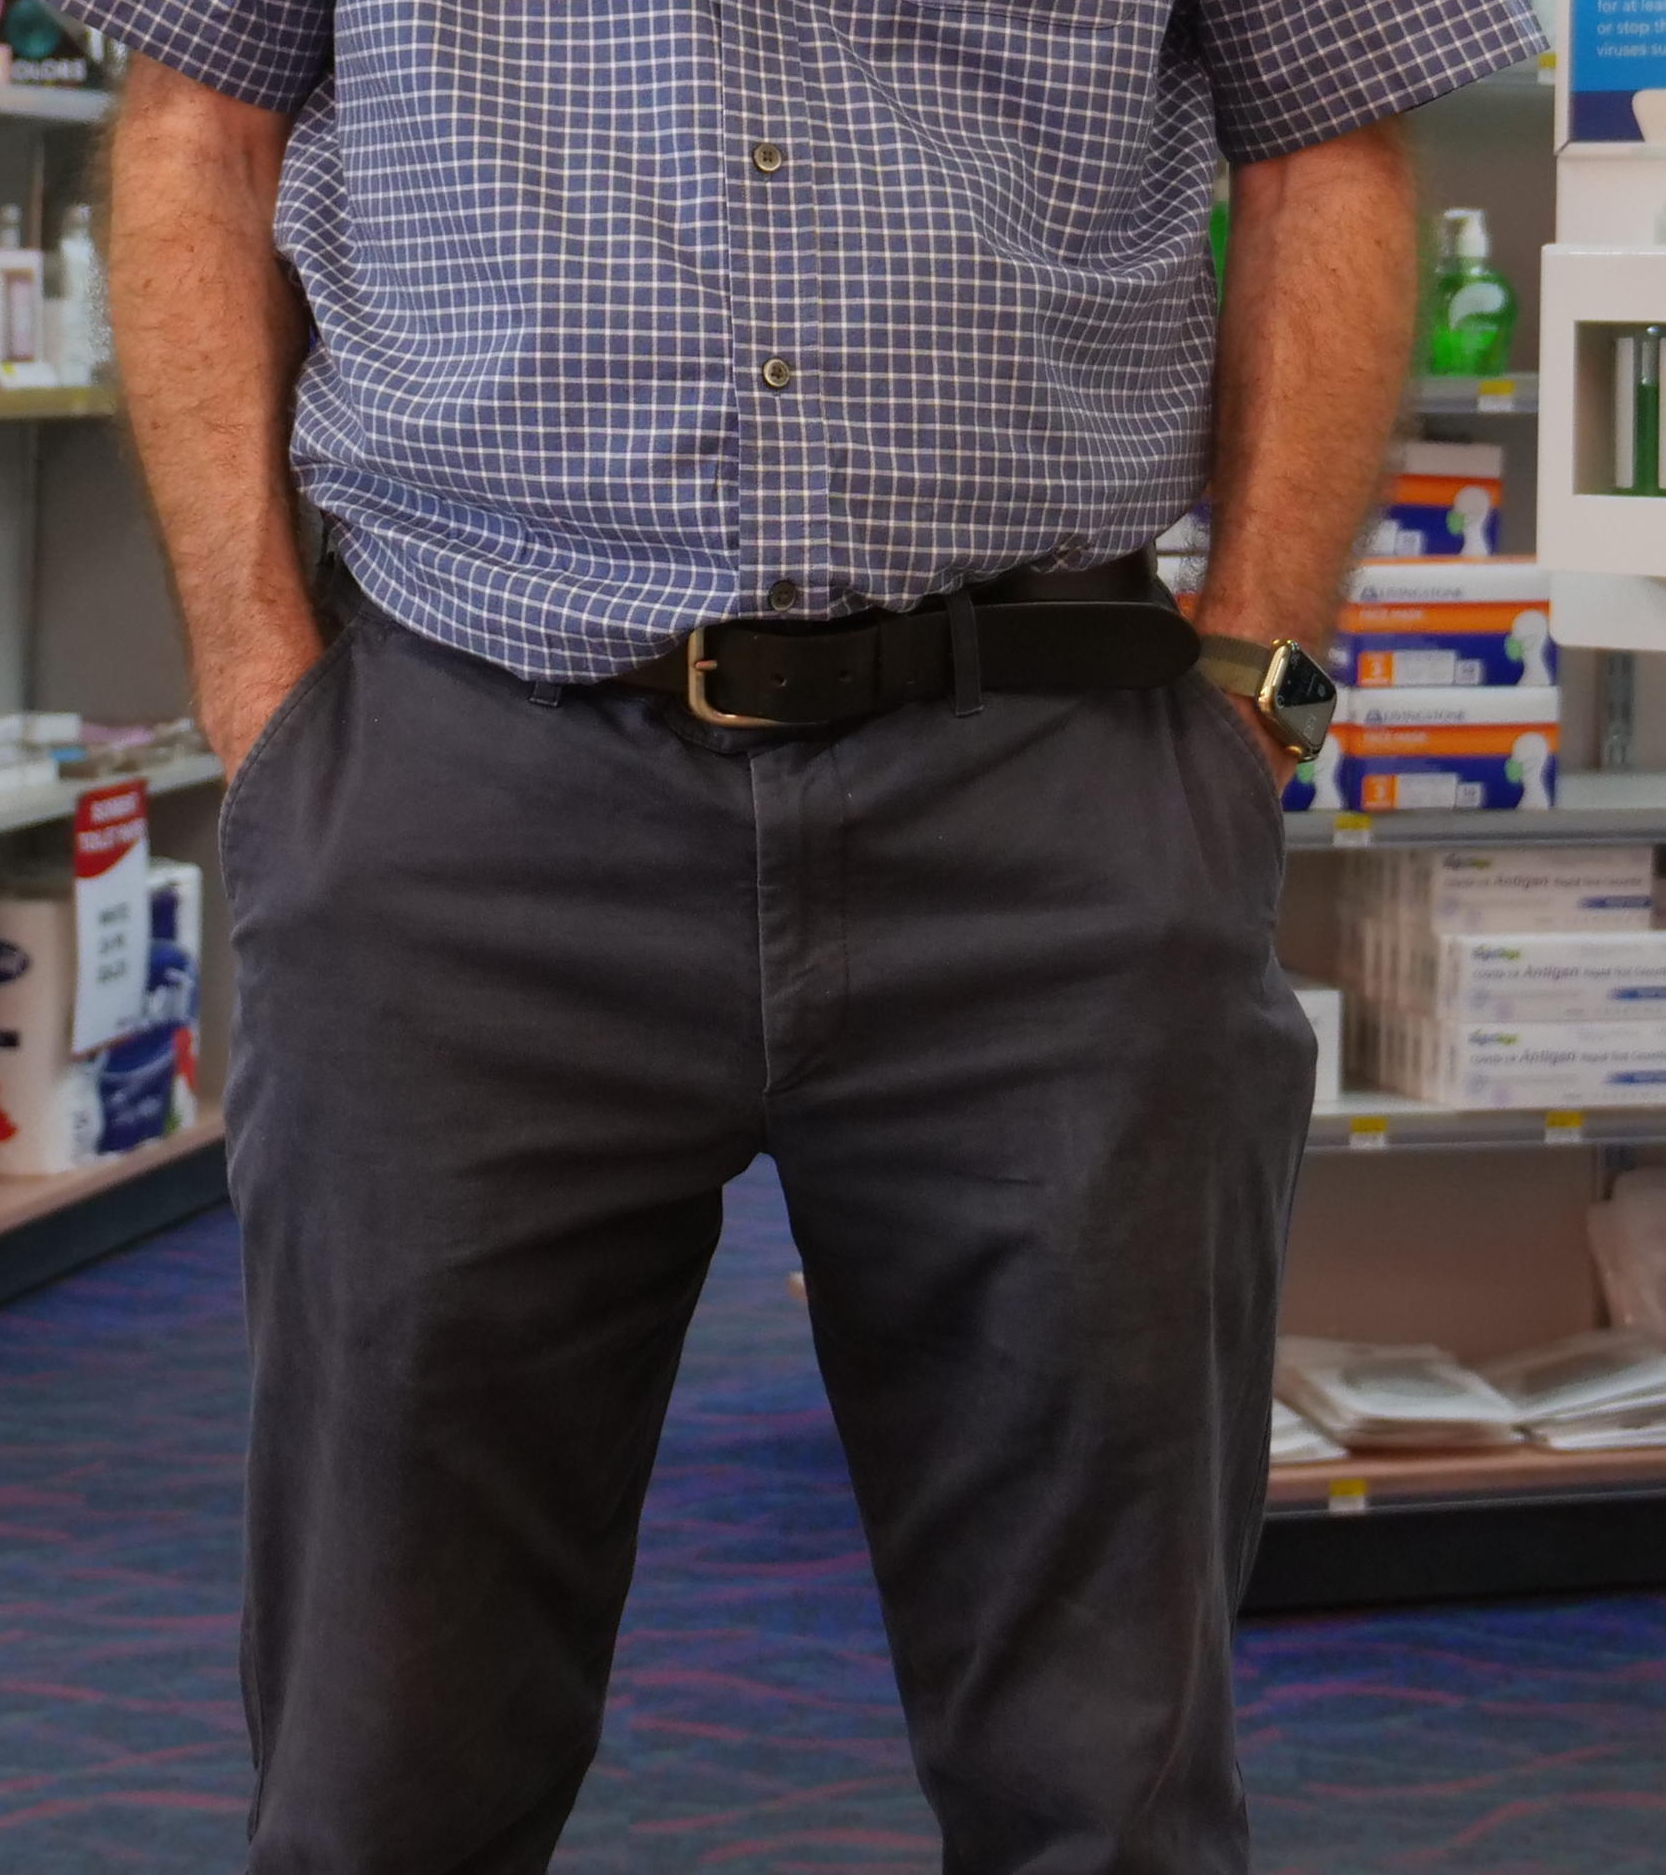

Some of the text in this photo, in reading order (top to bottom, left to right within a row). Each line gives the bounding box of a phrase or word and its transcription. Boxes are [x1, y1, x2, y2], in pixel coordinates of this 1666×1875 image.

[1597, 23, 1613, 36] or
[1617, 20, 1650, 37] stop
[1596, 43, 1647, 58] viruses
[11, 56, 86, 81] OLORS
